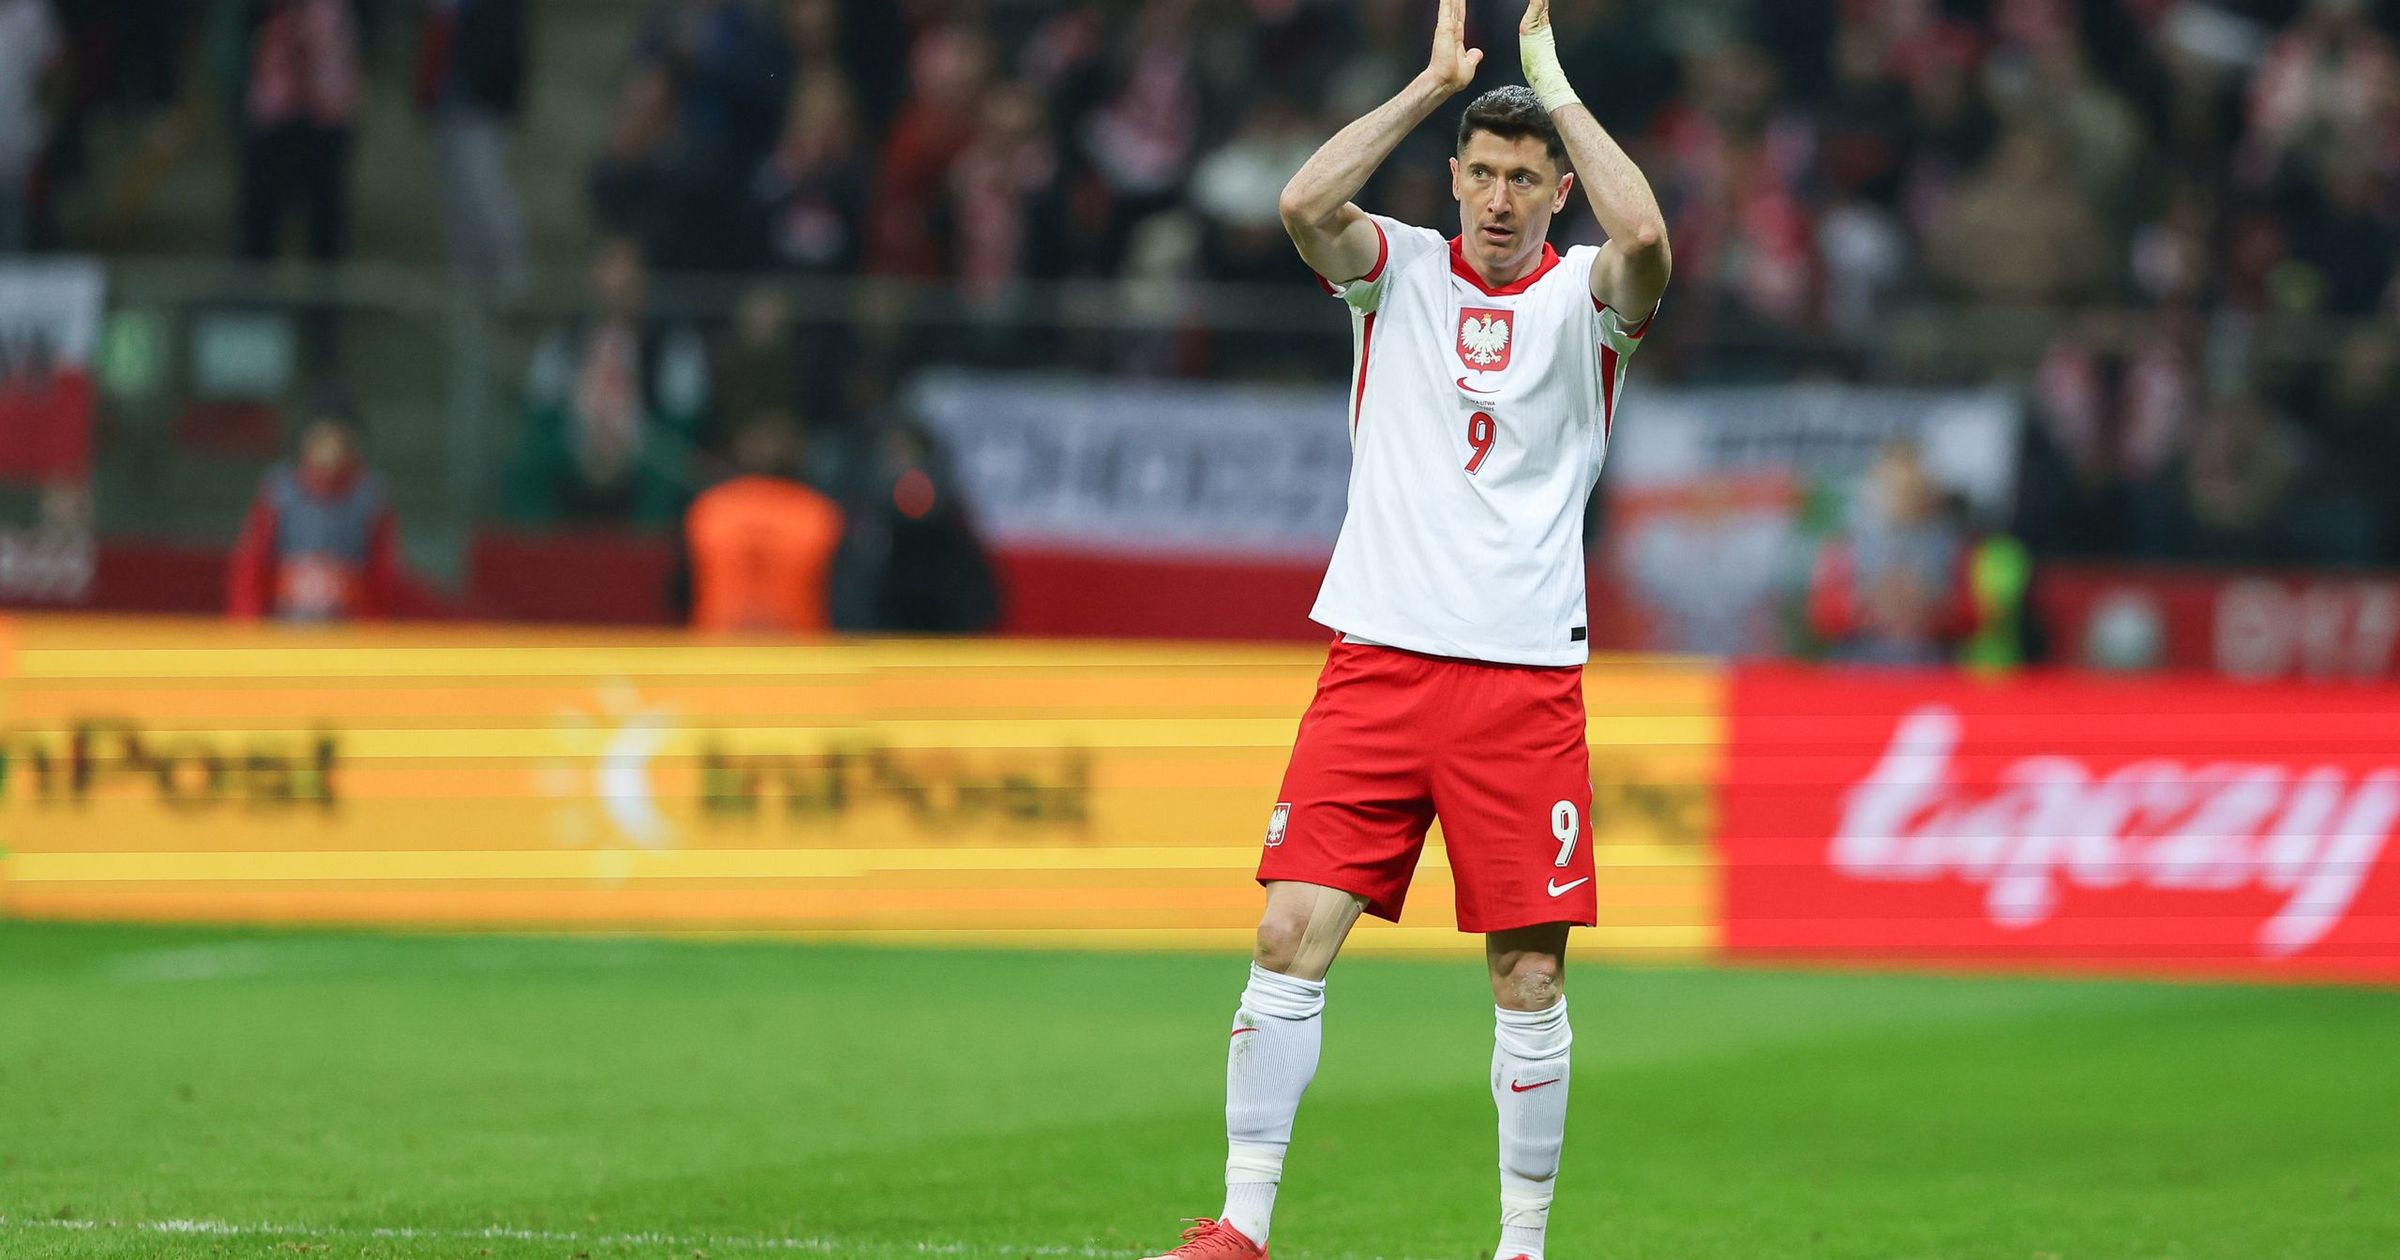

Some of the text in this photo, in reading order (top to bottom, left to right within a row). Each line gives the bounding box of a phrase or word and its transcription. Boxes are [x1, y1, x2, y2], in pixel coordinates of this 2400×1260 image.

[1464, 411, 1497, 476] 9
[1551, 800, 1579, 868] 9
[1826, 703, 2400, 960] Łączy
